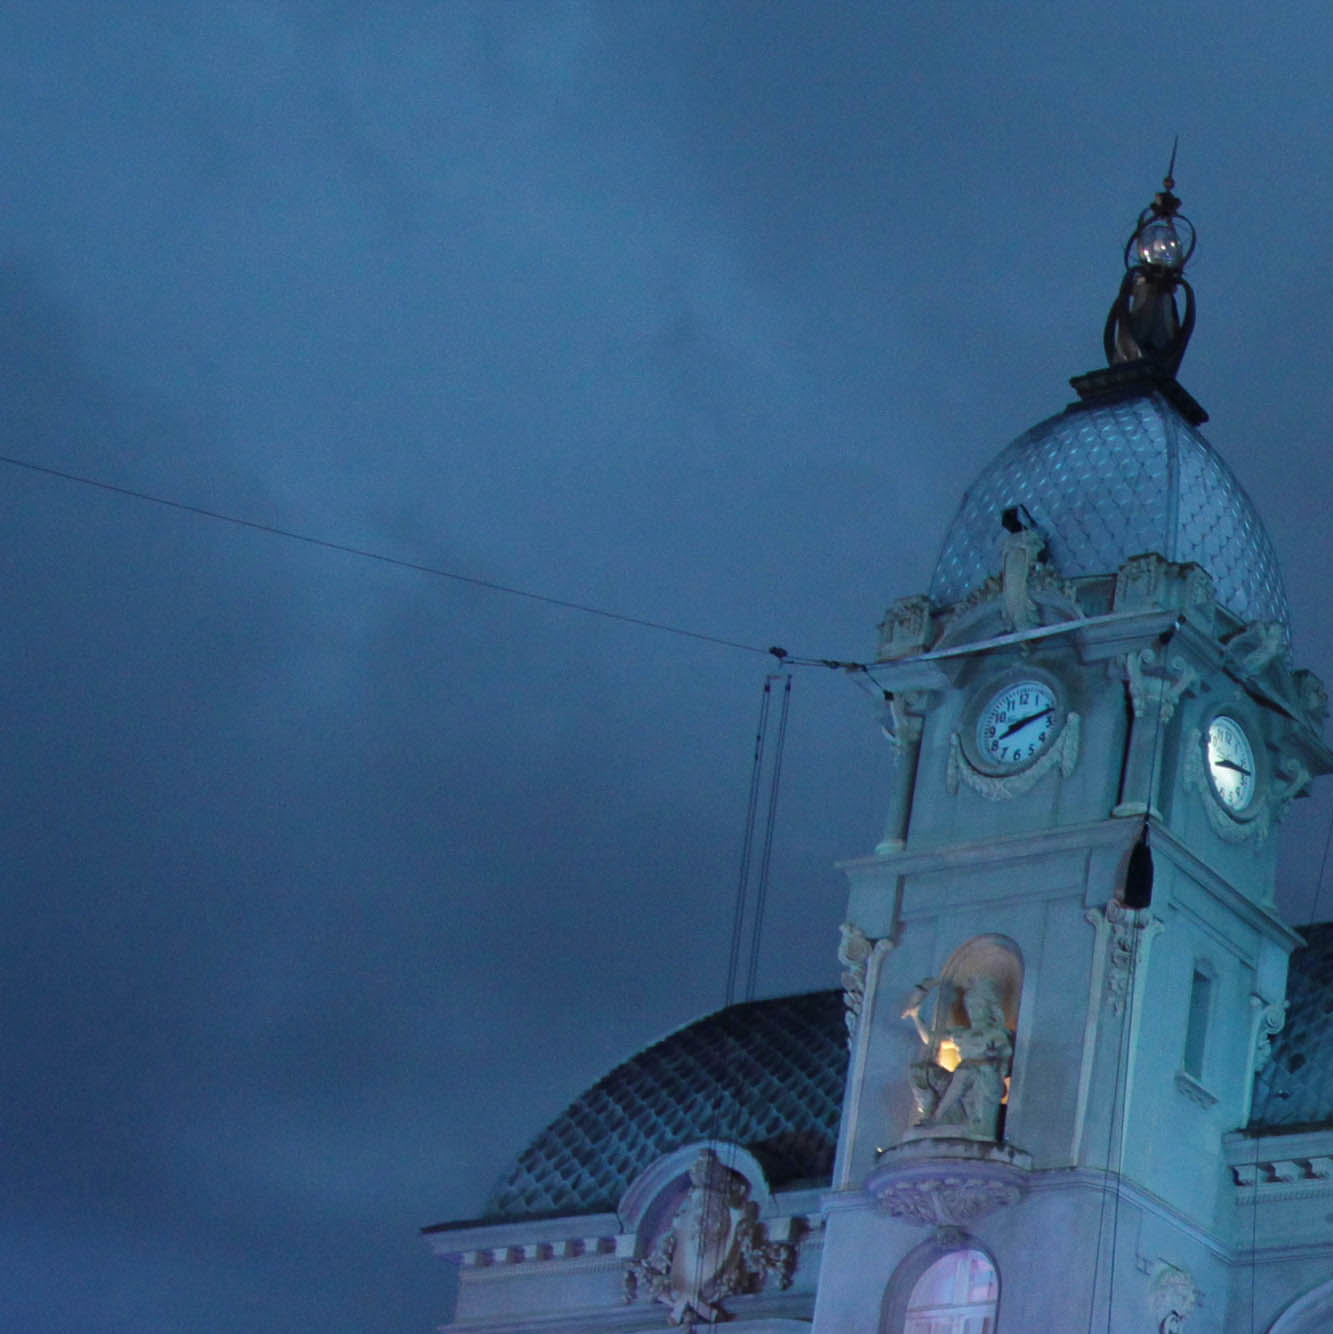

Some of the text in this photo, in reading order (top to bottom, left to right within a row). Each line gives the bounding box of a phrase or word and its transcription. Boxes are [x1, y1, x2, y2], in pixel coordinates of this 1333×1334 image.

[1019, 693, 1029, 705] 12
[1006, 700, 1015, 711] 11
[995, 711, 1007, 722] 10
[989, 726, 996, 738] 9
[1038, 732, 1046, 742] 4
[991, 740, 999, 751] 8
[1028, 744, 1034, 756] 5
[1002, 746, 1009, 758] 7
[1013, 749, 1021, 760] 6
